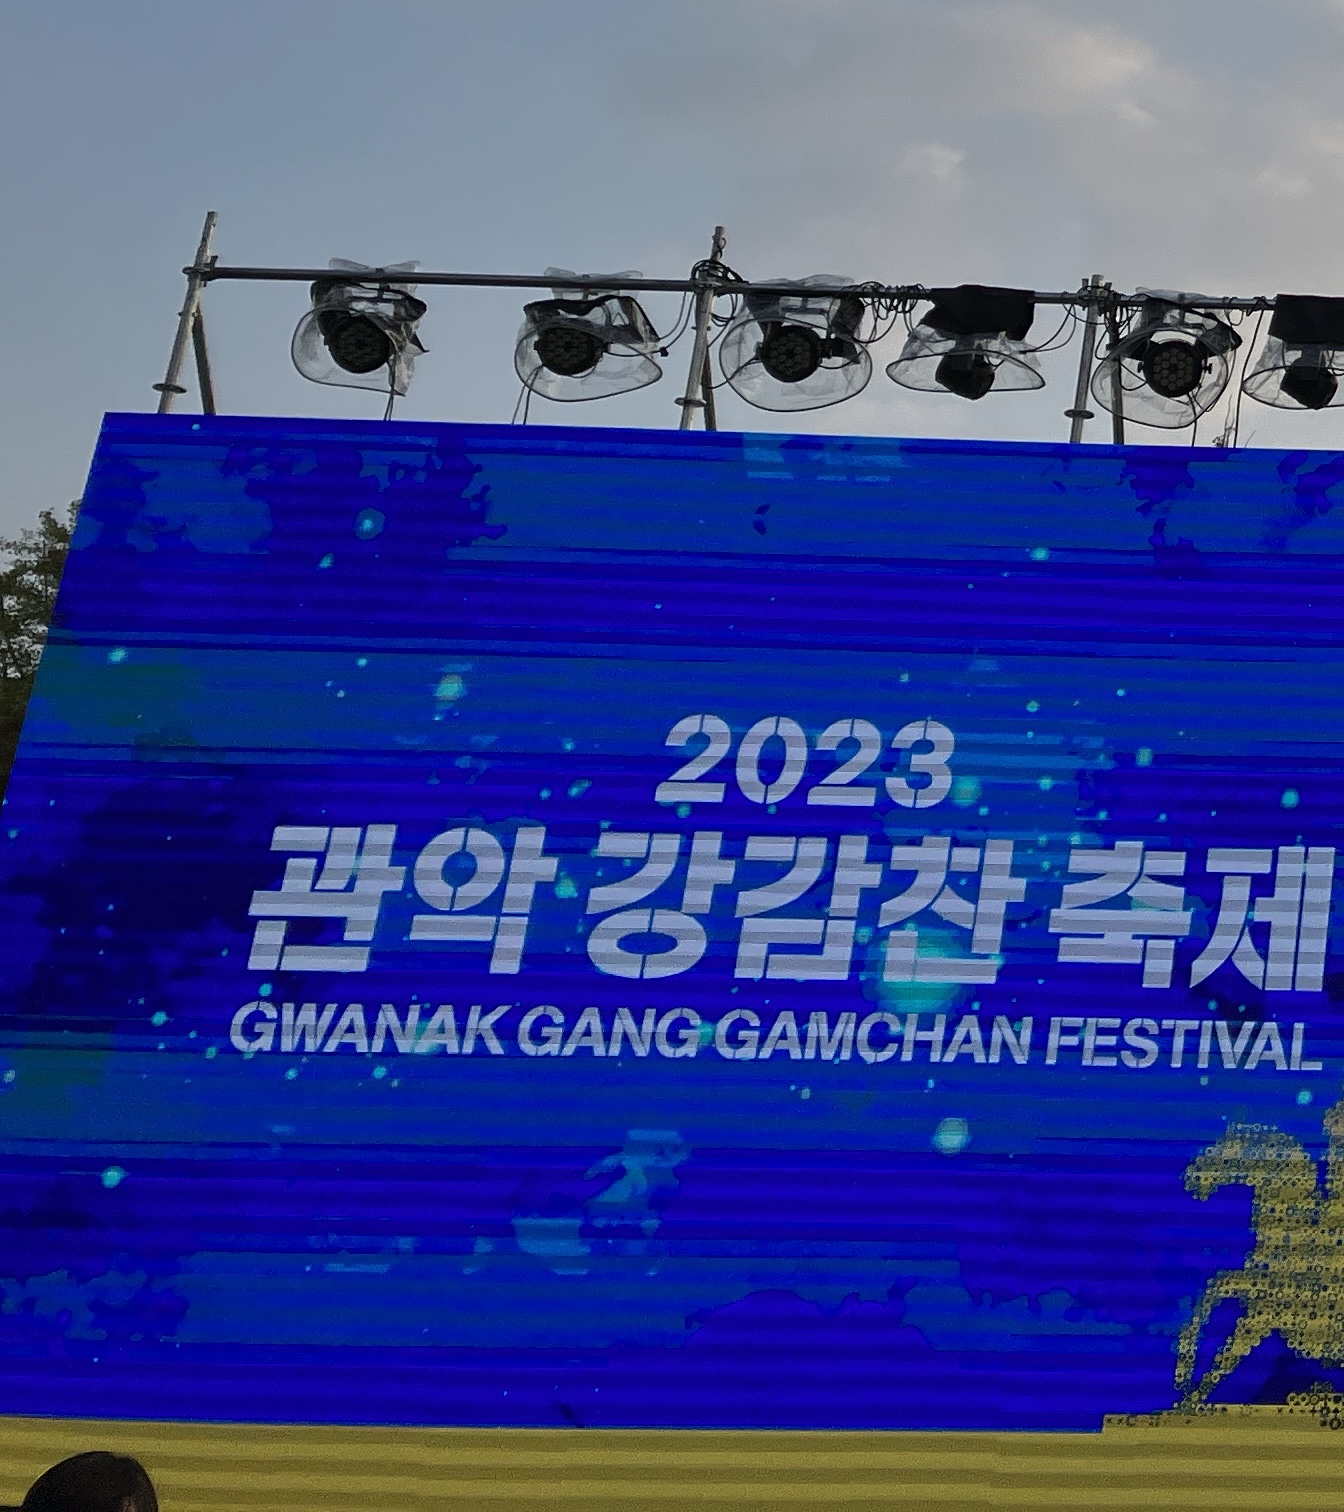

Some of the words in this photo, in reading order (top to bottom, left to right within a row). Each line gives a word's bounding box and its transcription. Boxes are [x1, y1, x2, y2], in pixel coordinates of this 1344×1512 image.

[654, 714, 956, 809] 2023
[248, 824, 559, 975] 관악
[586, 832, 1027, 982] 강감찬
[1047, 841, 1336, 991] 축제
[230, 1000, 511, 1055] GWANAK
[516, 1006, 701, 1058] GANG
[713, 1009, 1031, 1065] GAMCHAN
[1045, 1016, 1323, 1071] FESTIVAL
